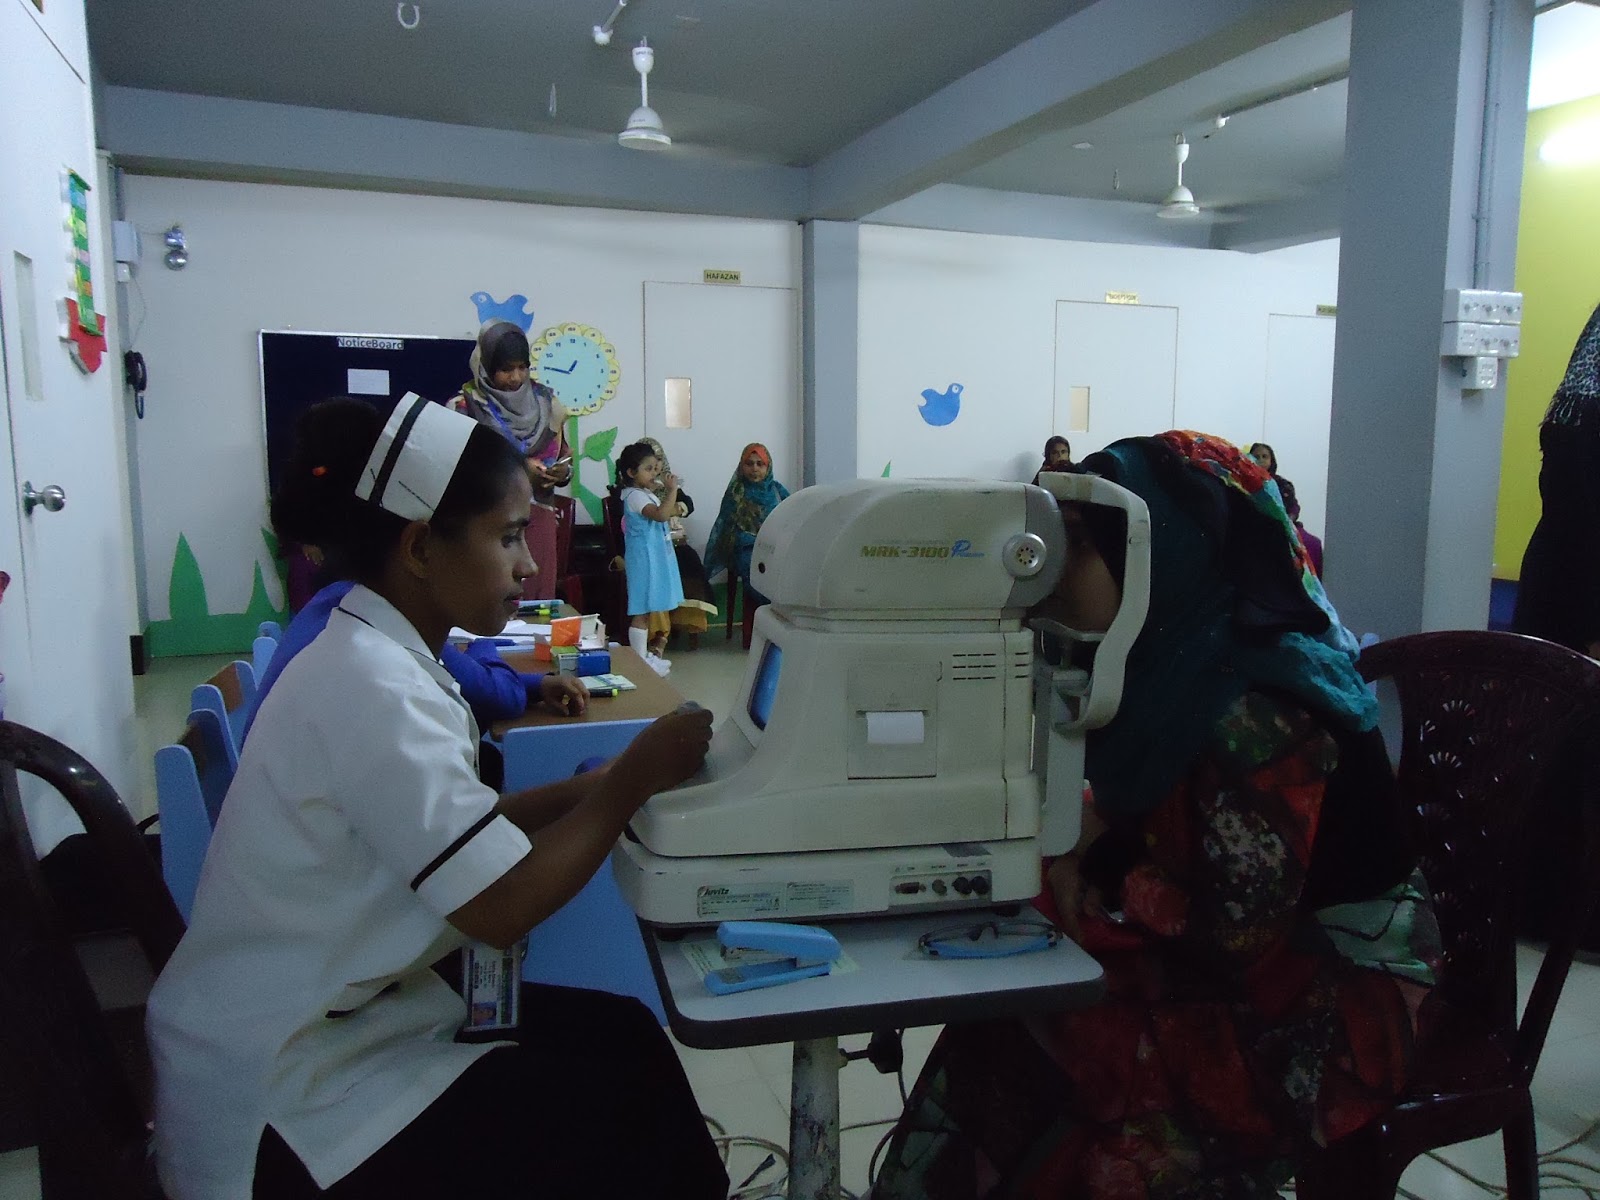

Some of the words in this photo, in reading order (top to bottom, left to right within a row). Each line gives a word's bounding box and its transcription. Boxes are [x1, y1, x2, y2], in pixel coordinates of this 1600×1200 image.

[706, 272, 739, 281] HAFAZAN
[338, 338, 404, 349] NoticeBoard
[861, 545, 949, 558] MRK-3100
